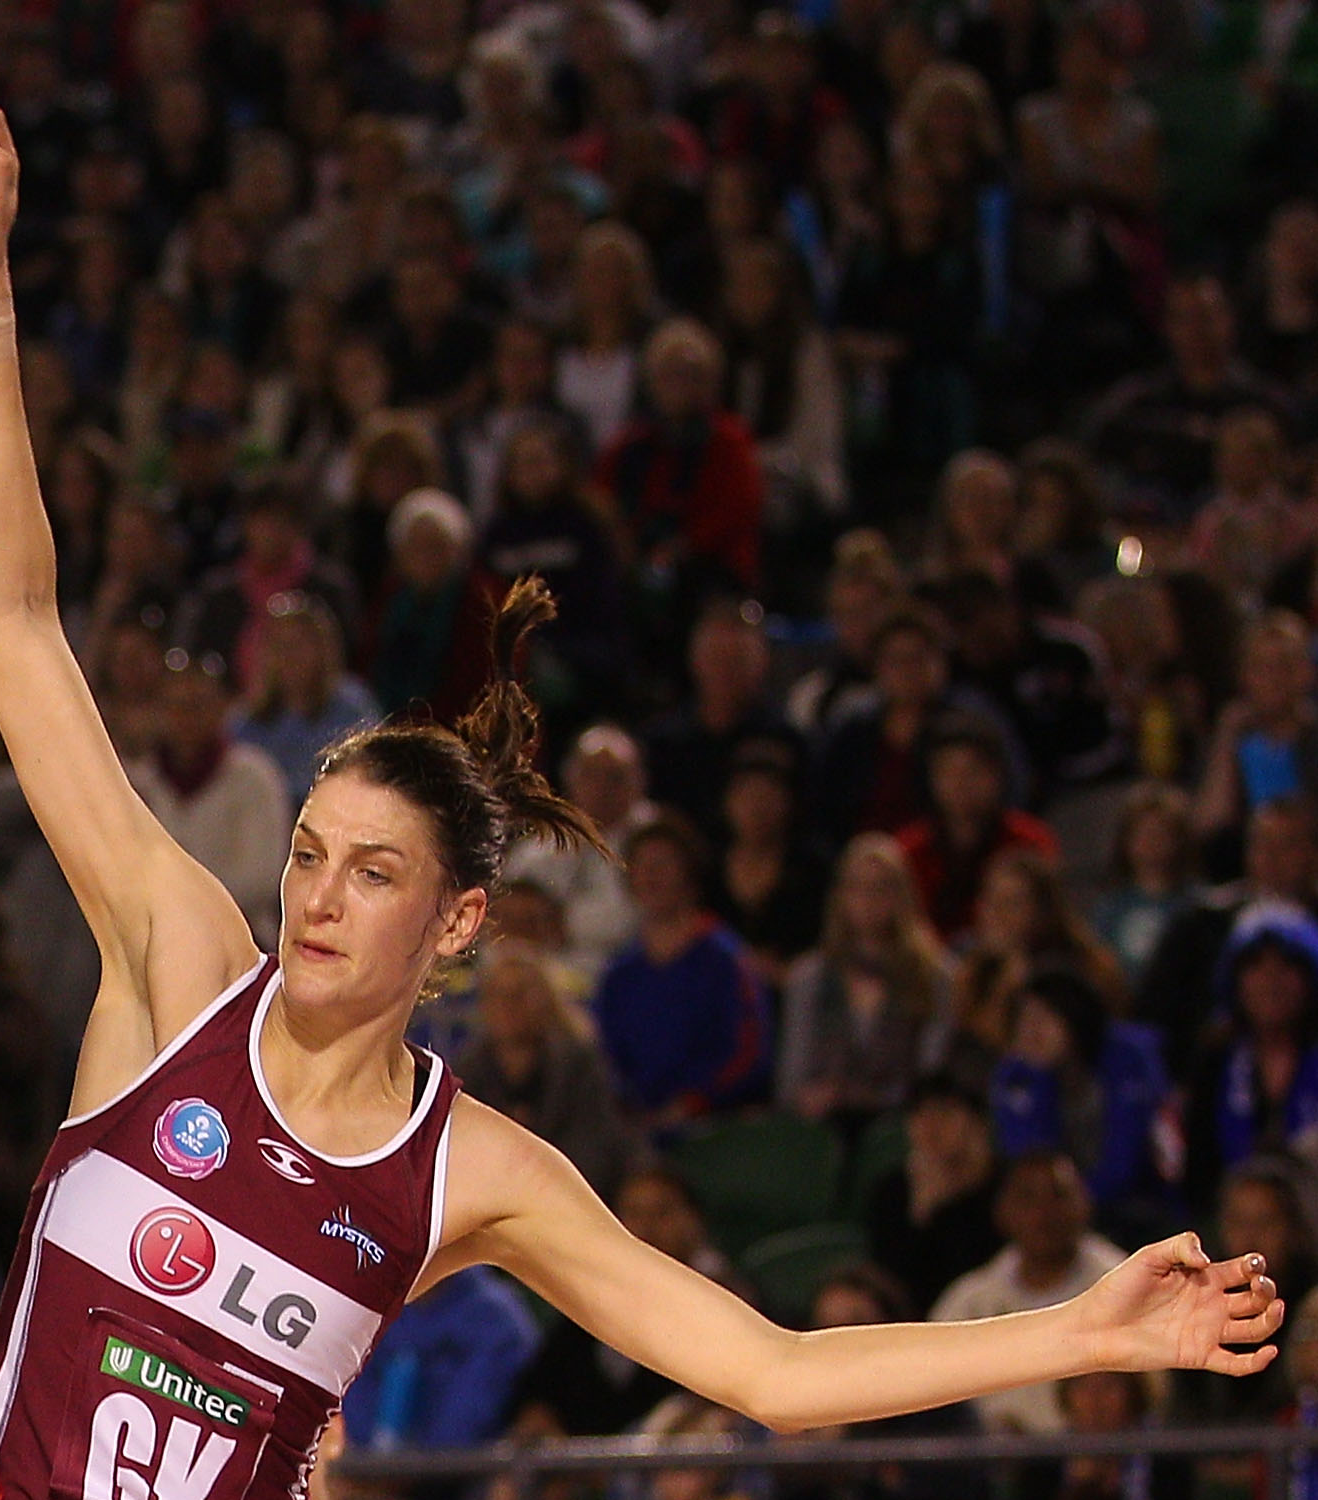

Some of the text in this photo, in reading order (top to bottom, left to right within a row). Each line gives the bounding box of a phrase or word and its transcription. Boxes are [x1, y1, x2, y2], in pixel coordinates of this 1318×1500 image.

[319, 1219, 386, 1265] MYSTICS
[218, 1263, 317, 1350] LG
[139, 1355, 244, 1425] Unitec
